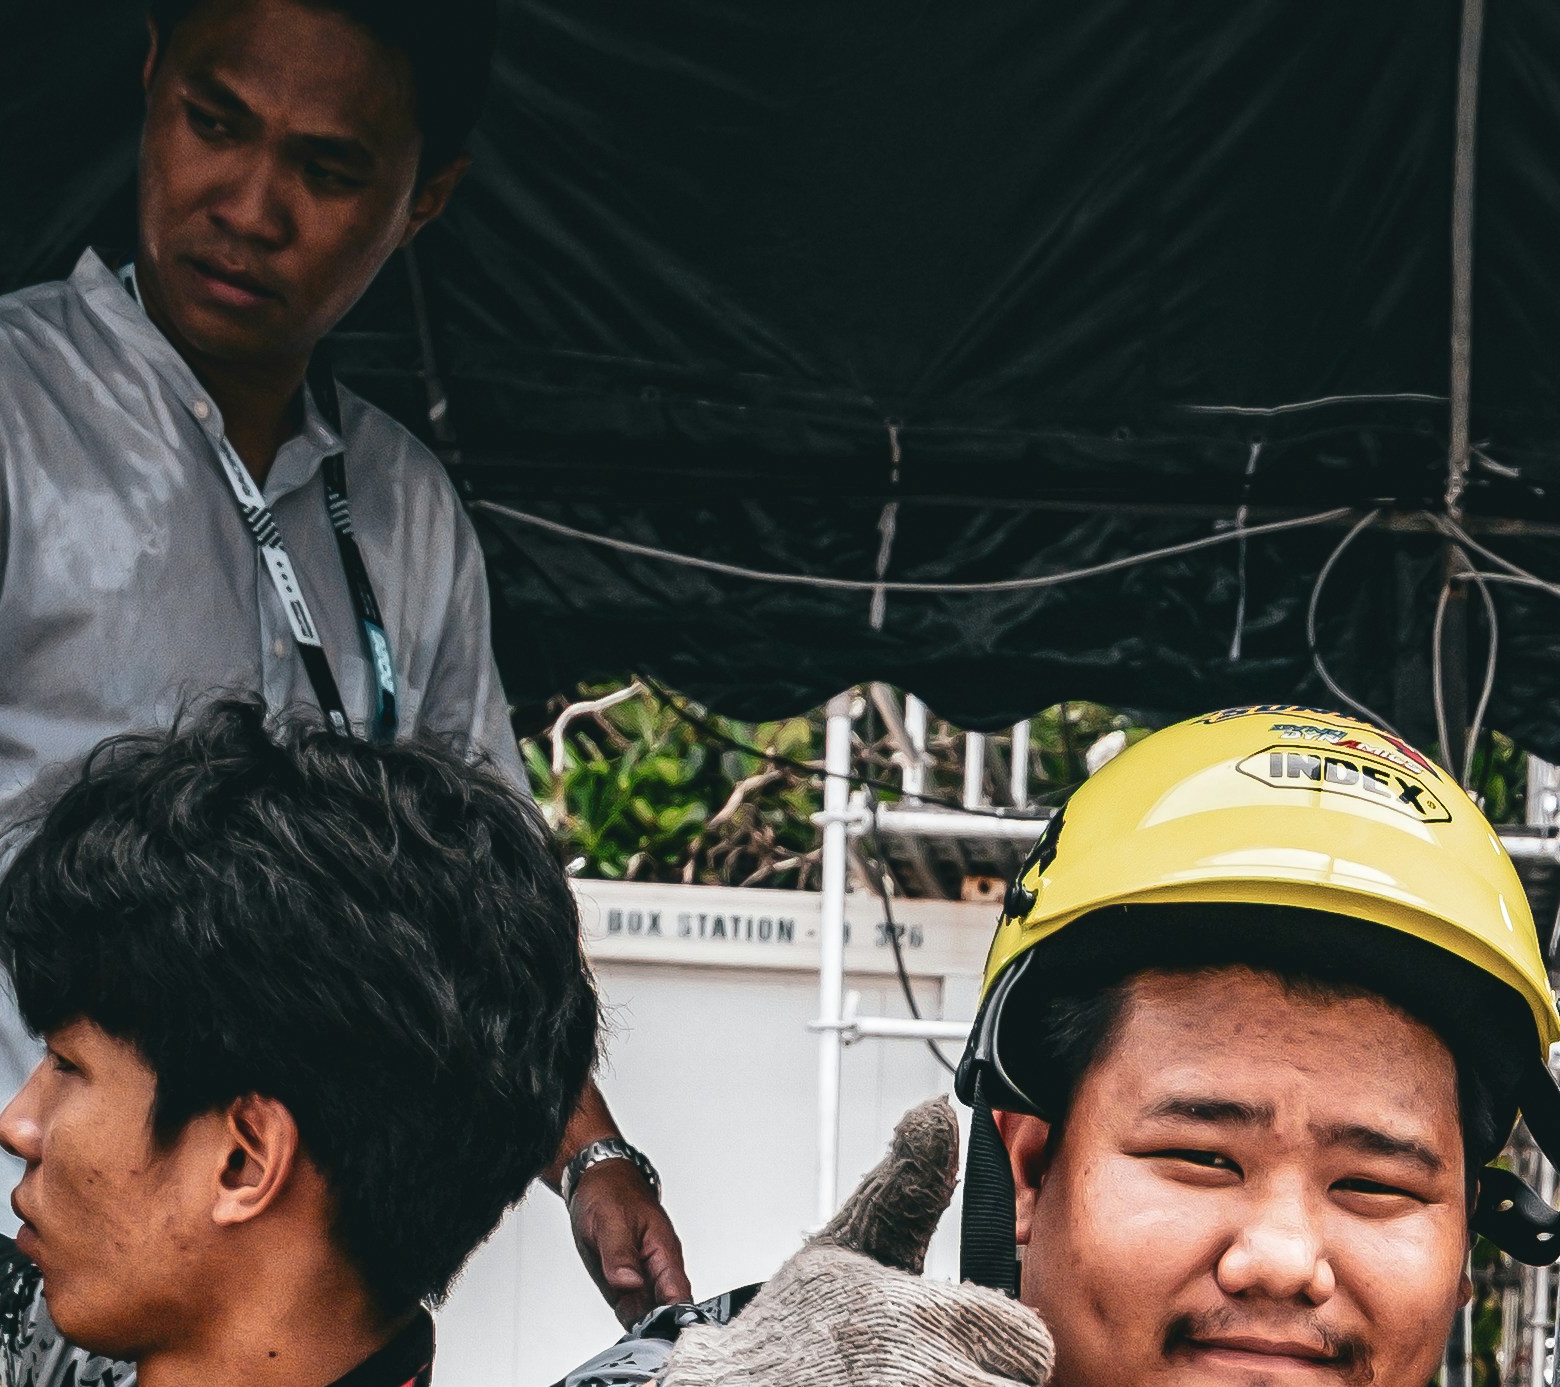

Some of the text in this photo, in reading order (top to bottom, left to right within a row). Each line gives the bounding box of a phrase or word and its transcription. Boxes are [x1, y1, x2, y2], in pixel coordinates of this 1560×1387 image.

[1269, 752, 1427, 816] INDEX
[607, 907, 661, 937] BOX
[679, 911, 795, 943] STATION
